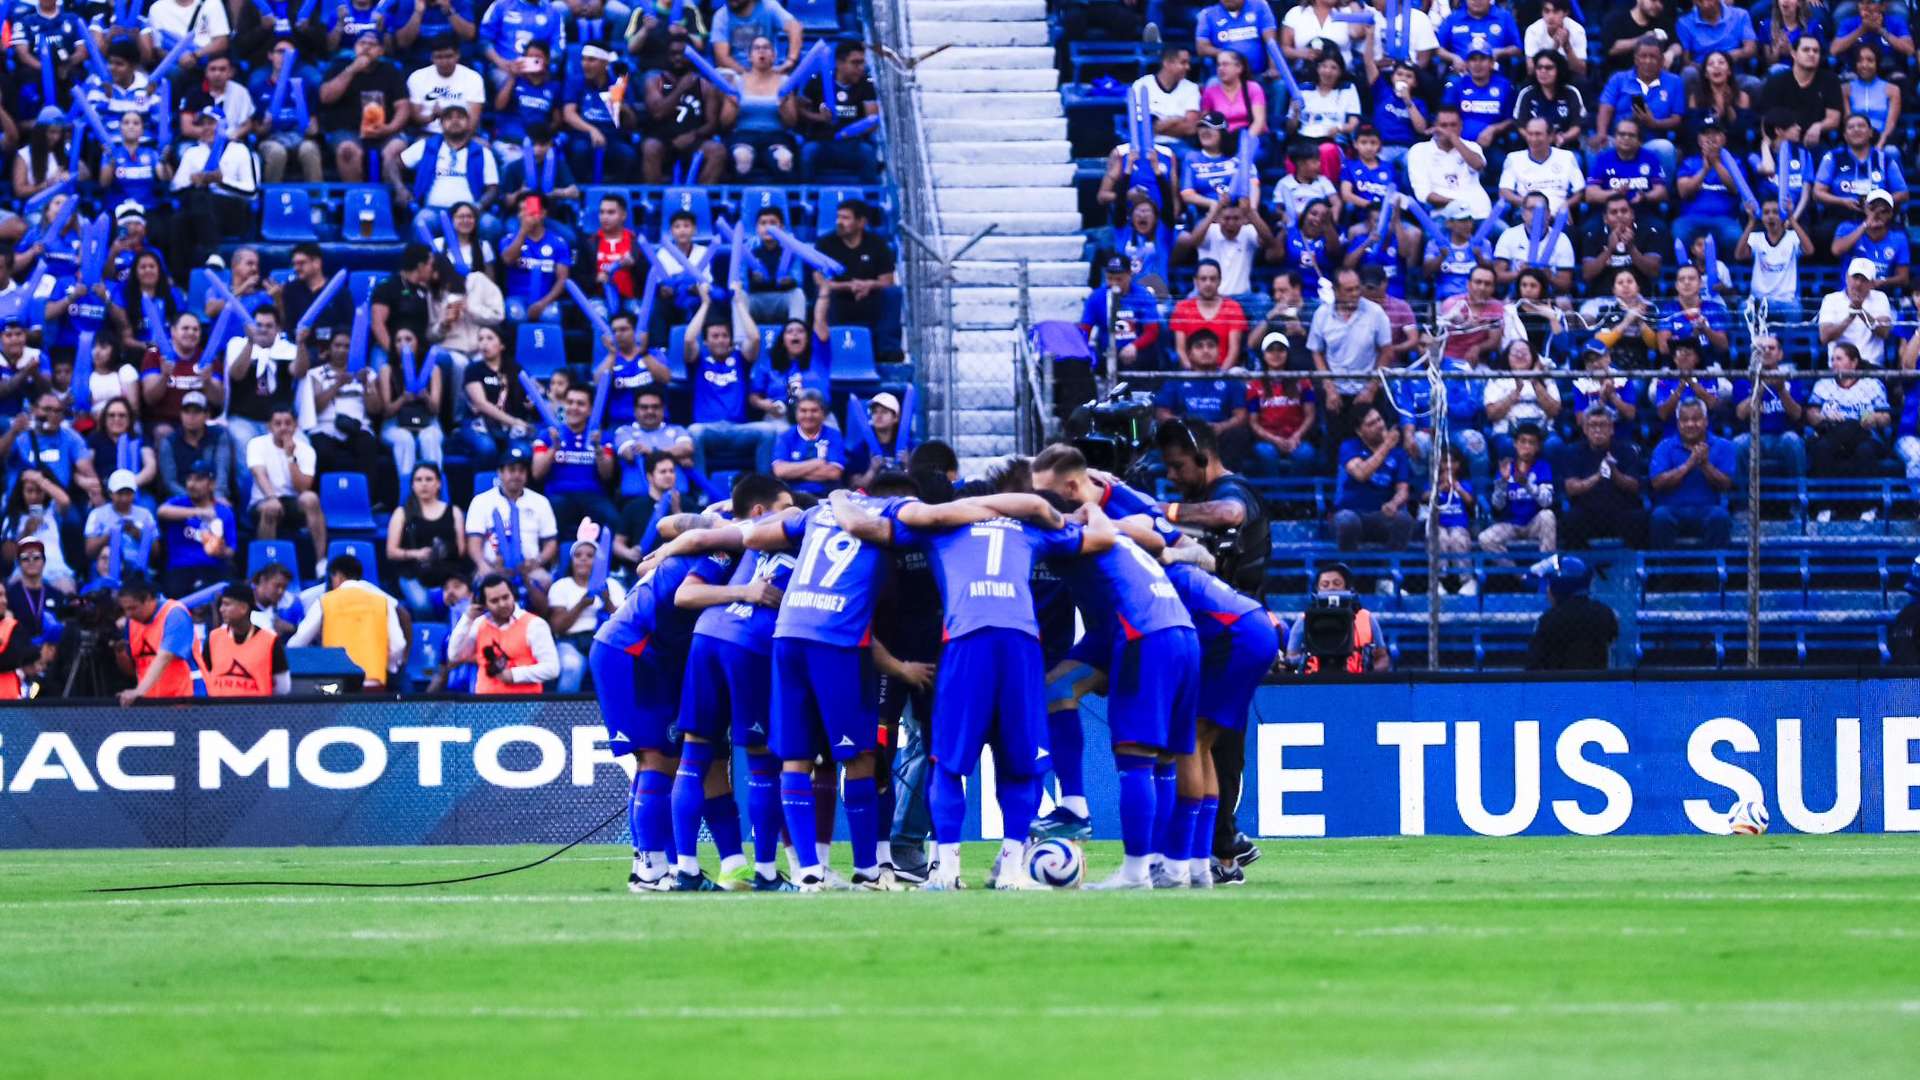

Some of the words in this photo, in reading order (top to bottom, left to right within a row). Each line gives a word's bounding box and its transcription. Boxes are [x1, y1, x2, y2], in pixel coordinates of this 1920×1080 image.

[798, 527, 862, 588] 19
[970, 527, 1005, 577] 7
[786, 591, 846, 613] RODRIGUEZ
[970, 580, 1016, 599] ANTUNA
[879, 674, 888, 705] IRMA
[0, 731, 176, 792] AC
[199, 725, 637, 790] MOTOR
[1236, 722, 1326, 837] E
[1377, 718, 1634, 837] TUS
[1683, 717, 1920, 836] SUE
